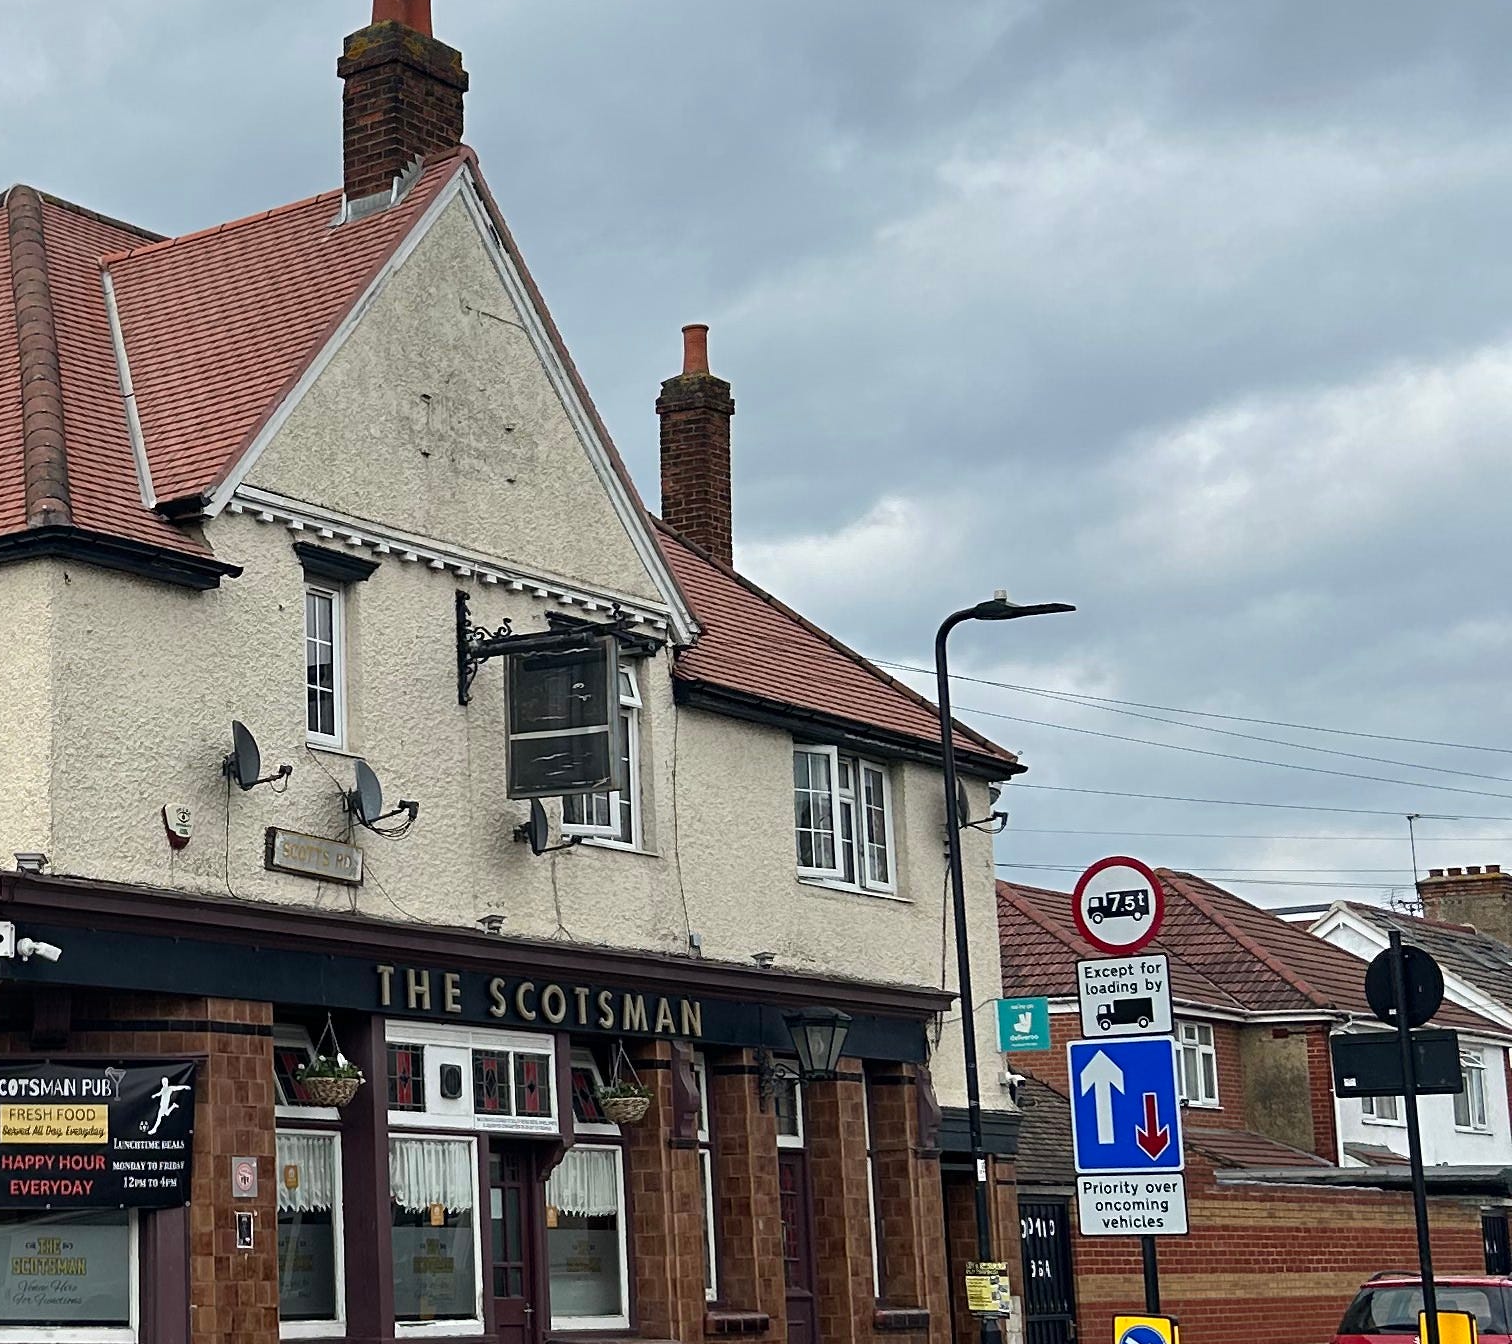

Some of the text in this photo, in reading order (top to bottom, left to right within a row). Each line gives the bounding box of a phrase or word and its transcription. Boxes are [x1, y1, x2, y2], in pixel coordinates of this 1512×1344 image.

[283, 842, 352, 869] SCOTTS RD
[1084, 962, 1162, 978] Except for
[1085, 978, 1162, 995] loading by
[377, 965, 703, 1037] THE SCOTSMAN
[82, 1078, 112, 1096] PUB
[9, 1108, 96, 1121] FRESH FOOD
[2, 1125, 31, 1136] Served
[32, 1125, 44, 1136] All
[65, 1125, 105, 1139] Everyday
[1, 1155, 106, 1170] HAPPY HOUR
[112, 1161, 185, 1171] MONDAY TO FRIDAY
[10, 1179, 94, 1195] EVERYDAY
[123, 1176, 178, 1188] 12PM TO 4PM
[1083, 1181, 1178, 1196] Priority over
[1095, 1198, 1169, 1213] oncoming
[1102, 1215, 1164, 1229] vehicles
[37, 1238, 62, 1255] THE
[12, 1258, 87, 1276] SCOTSMAN
